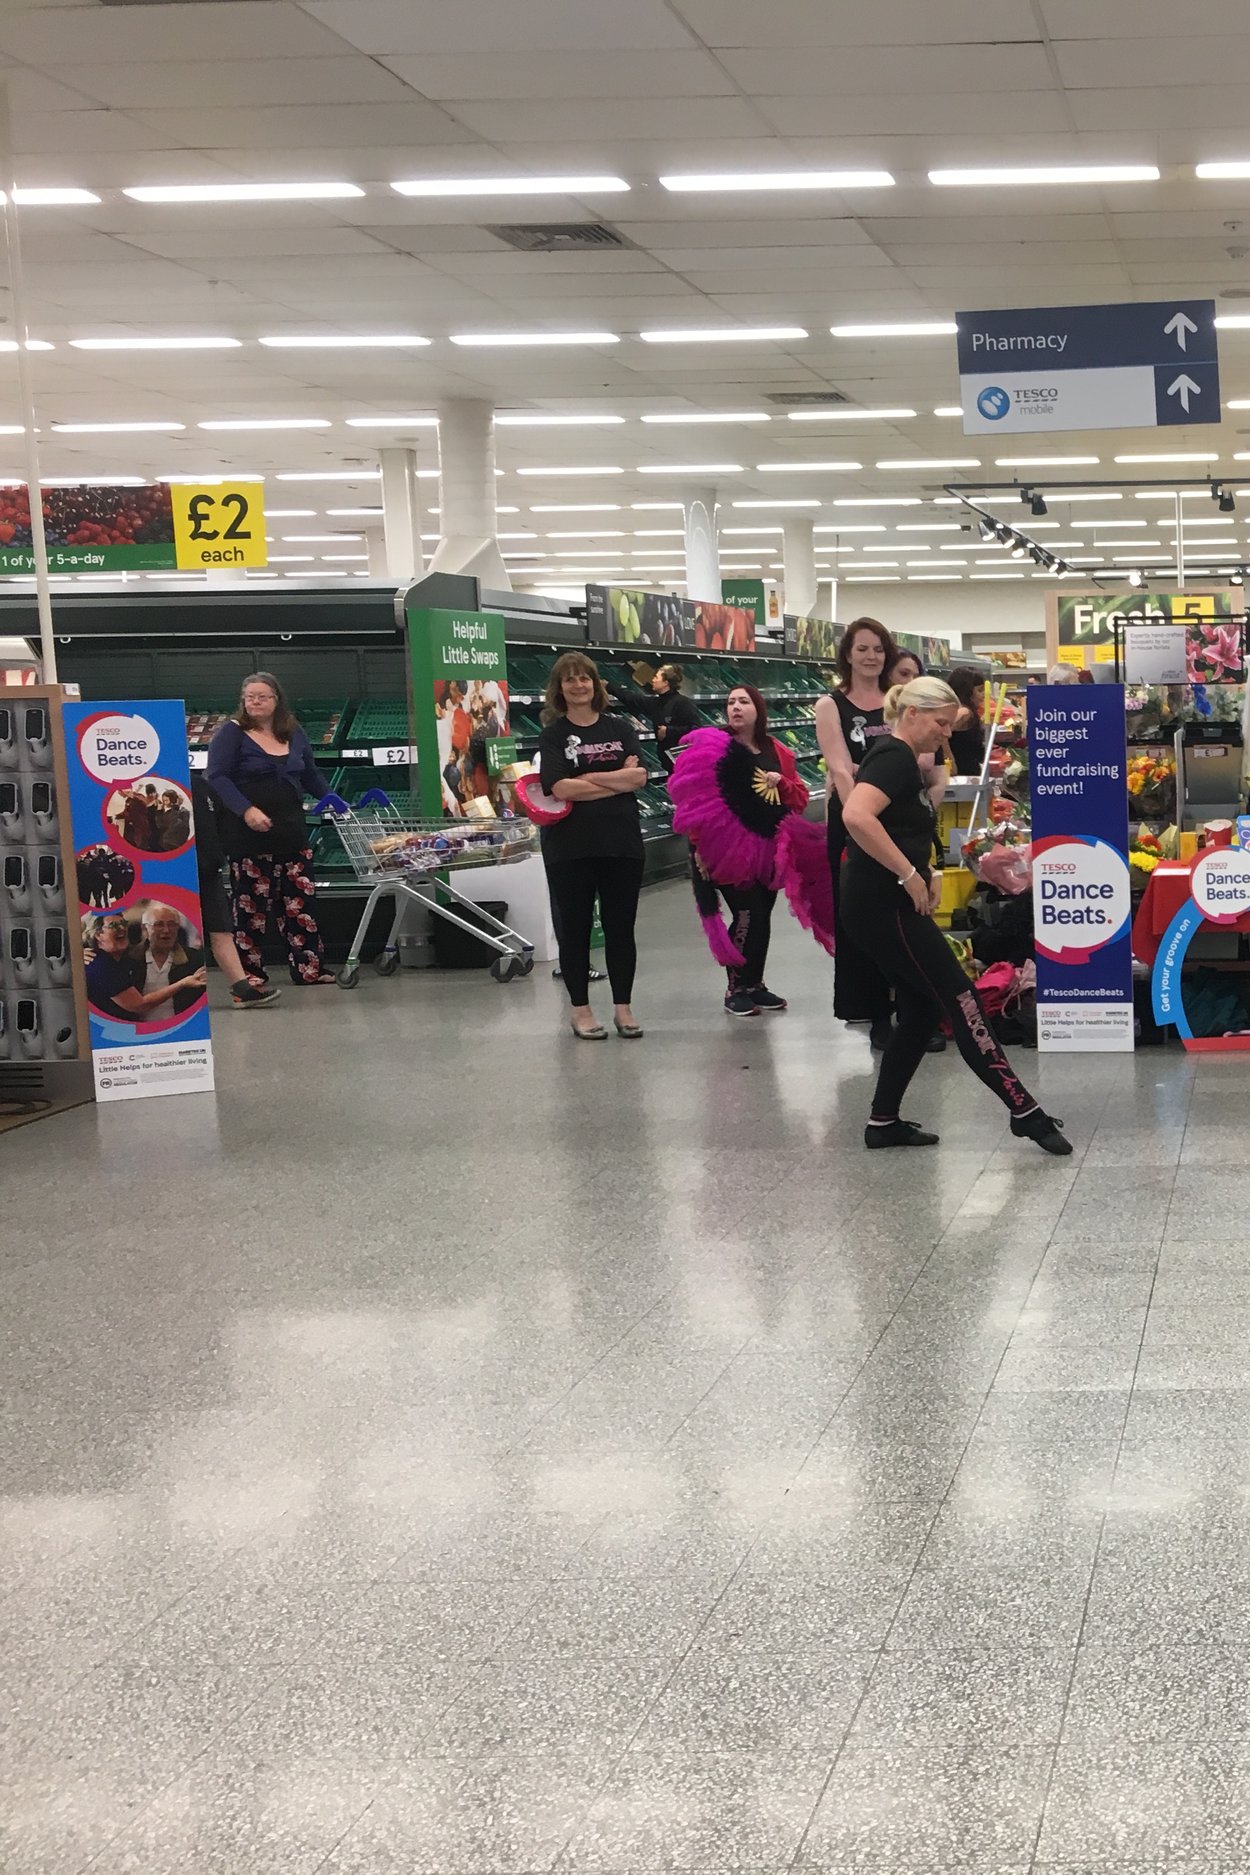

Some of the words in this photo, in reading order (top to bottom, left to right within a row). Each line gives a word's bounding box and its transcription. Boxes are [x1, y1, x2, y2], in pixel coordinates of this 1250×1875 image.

[972, 333, 1068, 352] Pharmacy
[1013, 388, 1058, 400] TESCO
[1020, 404, 1054, 415] mobile
[188, 493, 251, 541] £2
[2, 556, 7, 567] 1
[11, 555, 23, 566] of
[27, 554, 52, 569] yr
[57, 553, 105, 566] 5-a-day
[201, 546, 244, 562] each
[726, 596, 736, 604] of
[737, 597, 758, 605] your
[1074, 603, 1165, 634] Fresh
[453, 621, 487, 643] Helpful
[443, 646, 469, 664] Little
[471, 647, 499, 669] Swaps
[1035, 709, 1066, 722] Join
[1071, 710, 1097, 721] our
[1035, 727, 1088, 743] biggest
[96, 738, 147, 751] Dance
[98, 754, 147, 766] Beats.
[387, 750, 405, 763] £2
[1036, 748, 1069, 758] ever
[1037, 763, 1119, 779] fundraising
[1037, 782, 1083, 795] event!
[1041, 864, 1076, 872] TESCO
[1206, 873, 1250, 885] Dance
[1041, 880, 1114, 900] Dance
[1207, 888, 1250, 900] Beats.
[1042, 905, 1113, 925] Beats.
[1180, 918, 1191, 932] on
[1165, 932, 1183, 966] groove
[1162, 967, 1171, 991] your
[1043, 988, 1124, 997] #TescoDanceBeats
[1161, 993, 1170, 1012] Get
[120, 1064, 140, 1072] Helps
[154, 1060, 187, 1068] healthier
